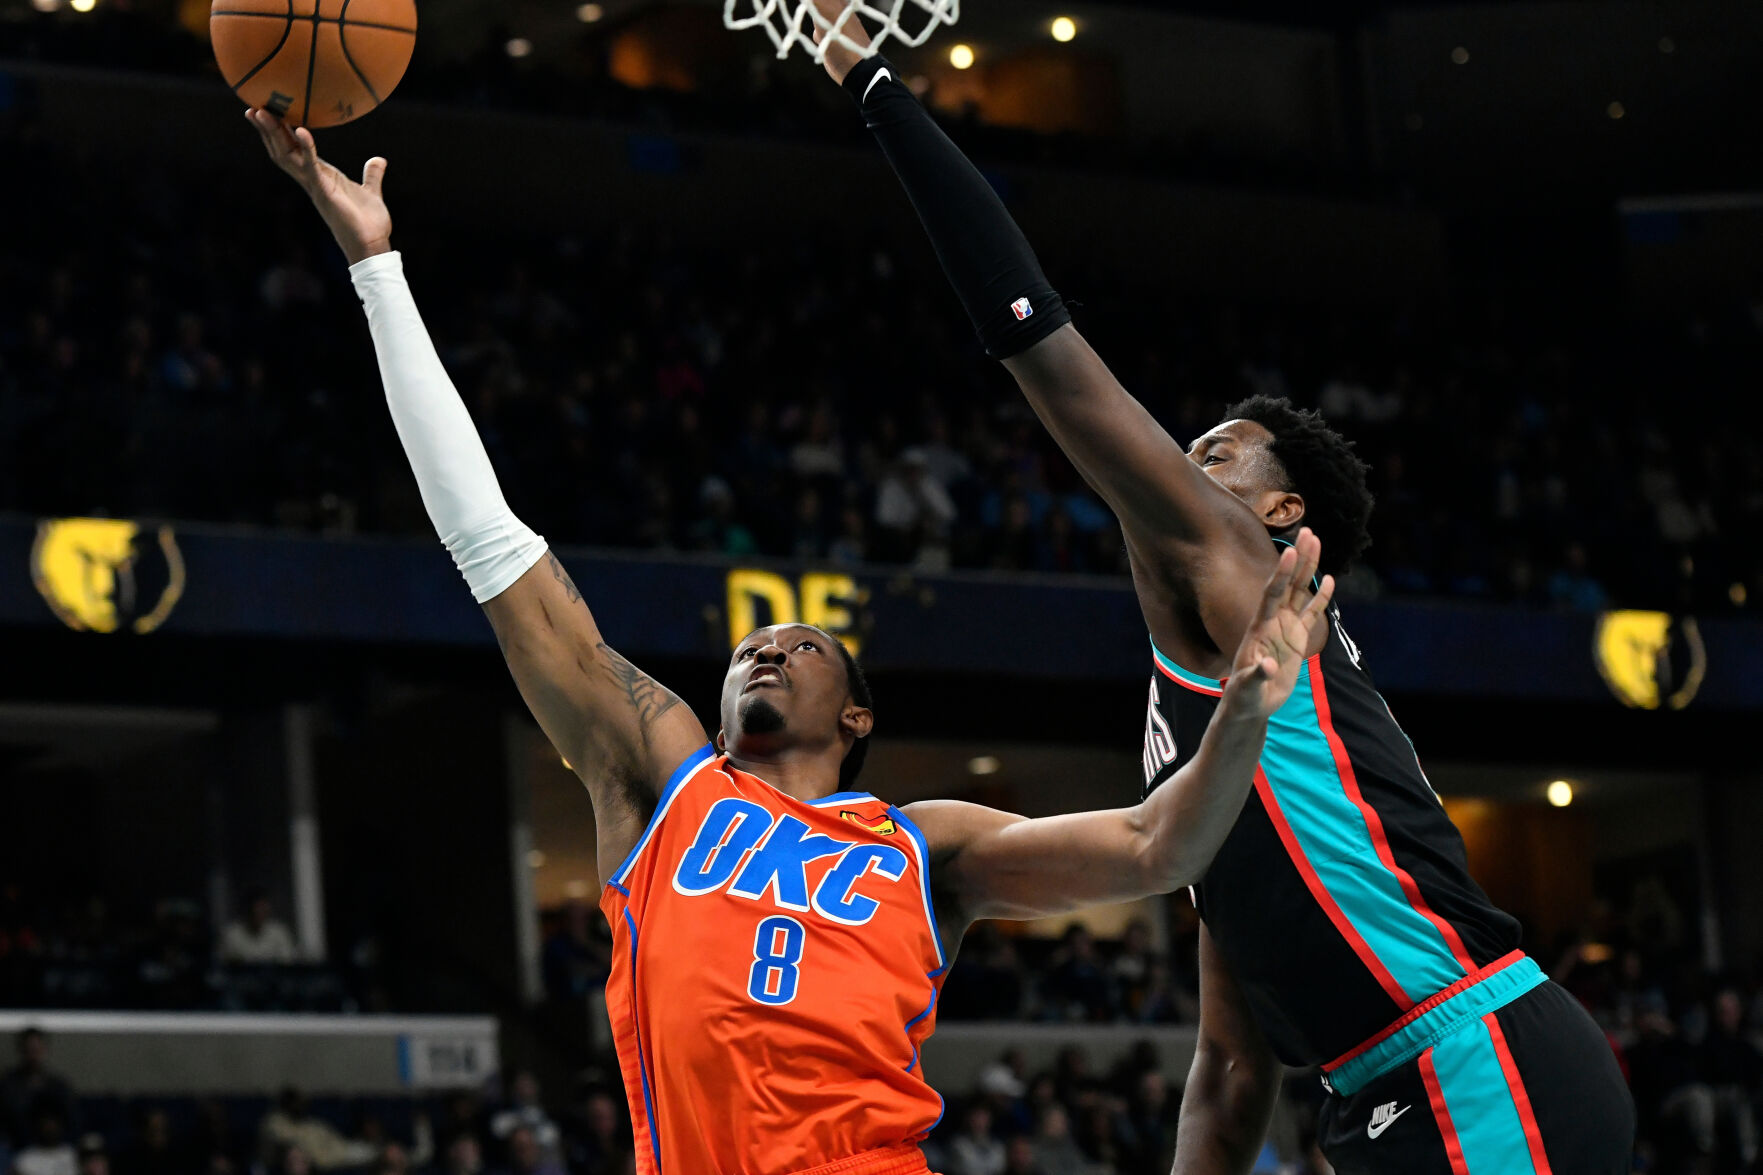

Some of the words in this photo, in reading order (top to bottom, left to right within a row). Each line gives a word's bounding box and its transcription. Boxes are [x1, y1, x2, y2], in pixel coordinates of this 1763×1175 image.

[672, 797, 908, 926] OKC
[747, 914, 806, 1006] 8
[1371, 1100, 1398, 1126] NIKE
